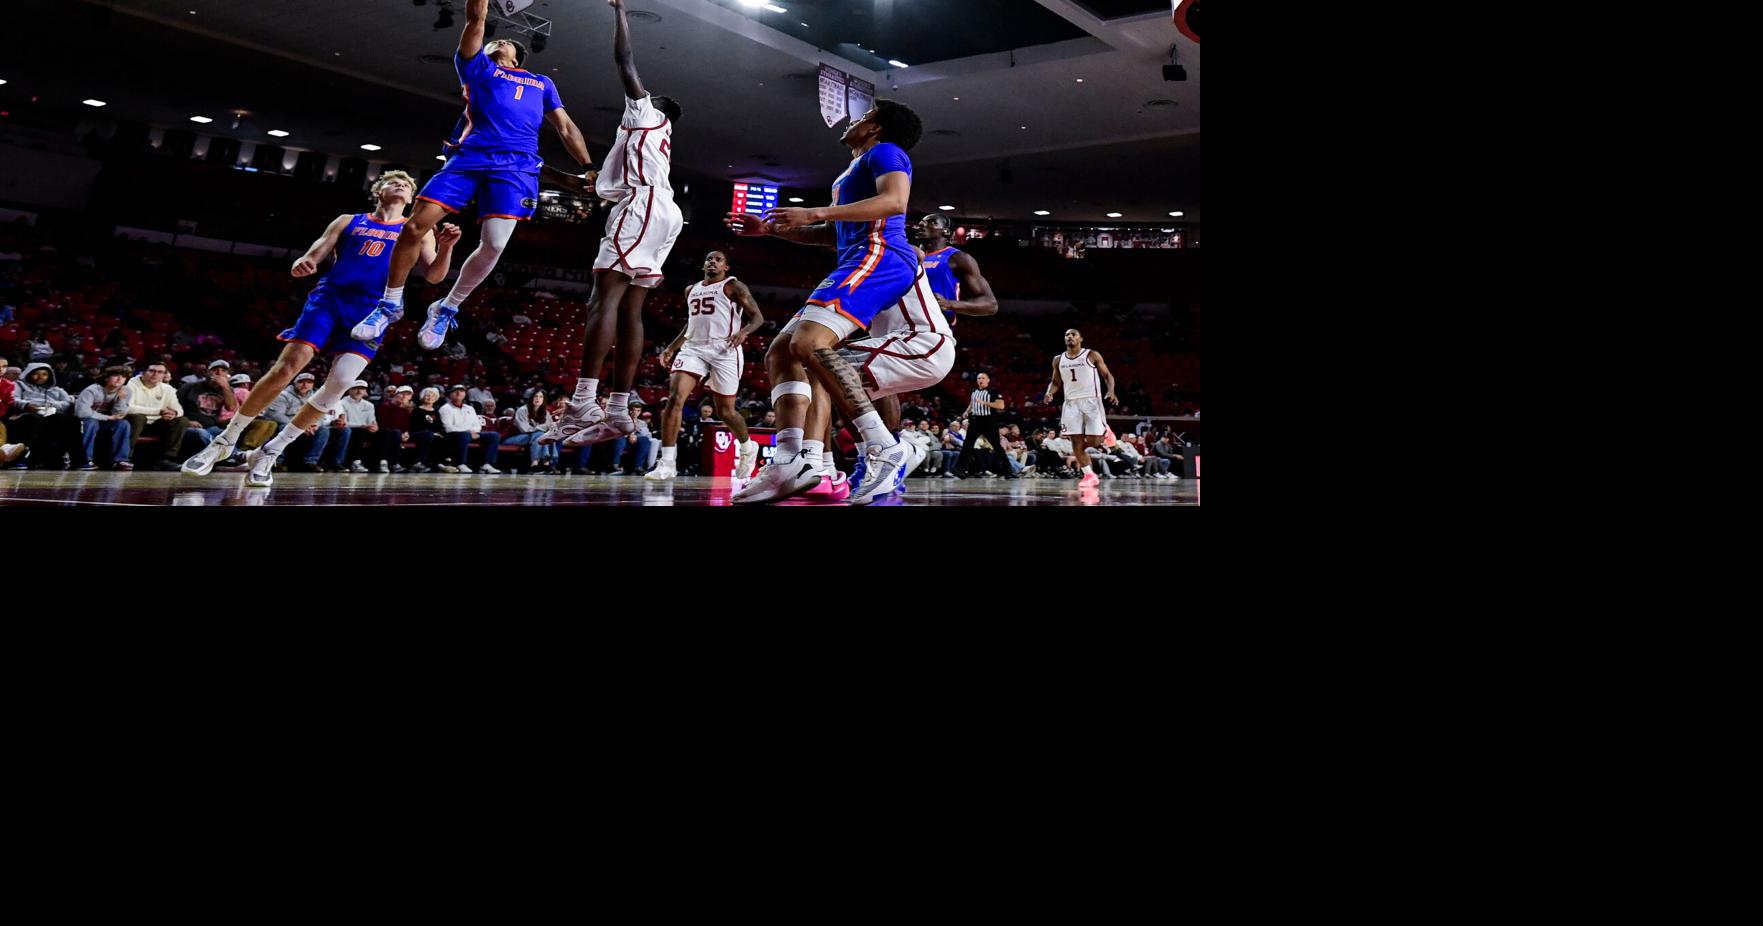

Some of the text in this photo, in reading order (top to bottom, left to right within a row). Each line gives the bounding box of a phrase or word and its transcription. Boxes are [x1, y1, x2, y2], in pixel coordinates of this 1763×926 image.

[514, 85, 524, 100] 1
[351, 226, 400, 242] FLORID
[358, 239, 386, 257] 10
[690, 297, 715, 316] 35
[1070, 368, 1077, 382] 1
[715, 431, 731, 450] OU
